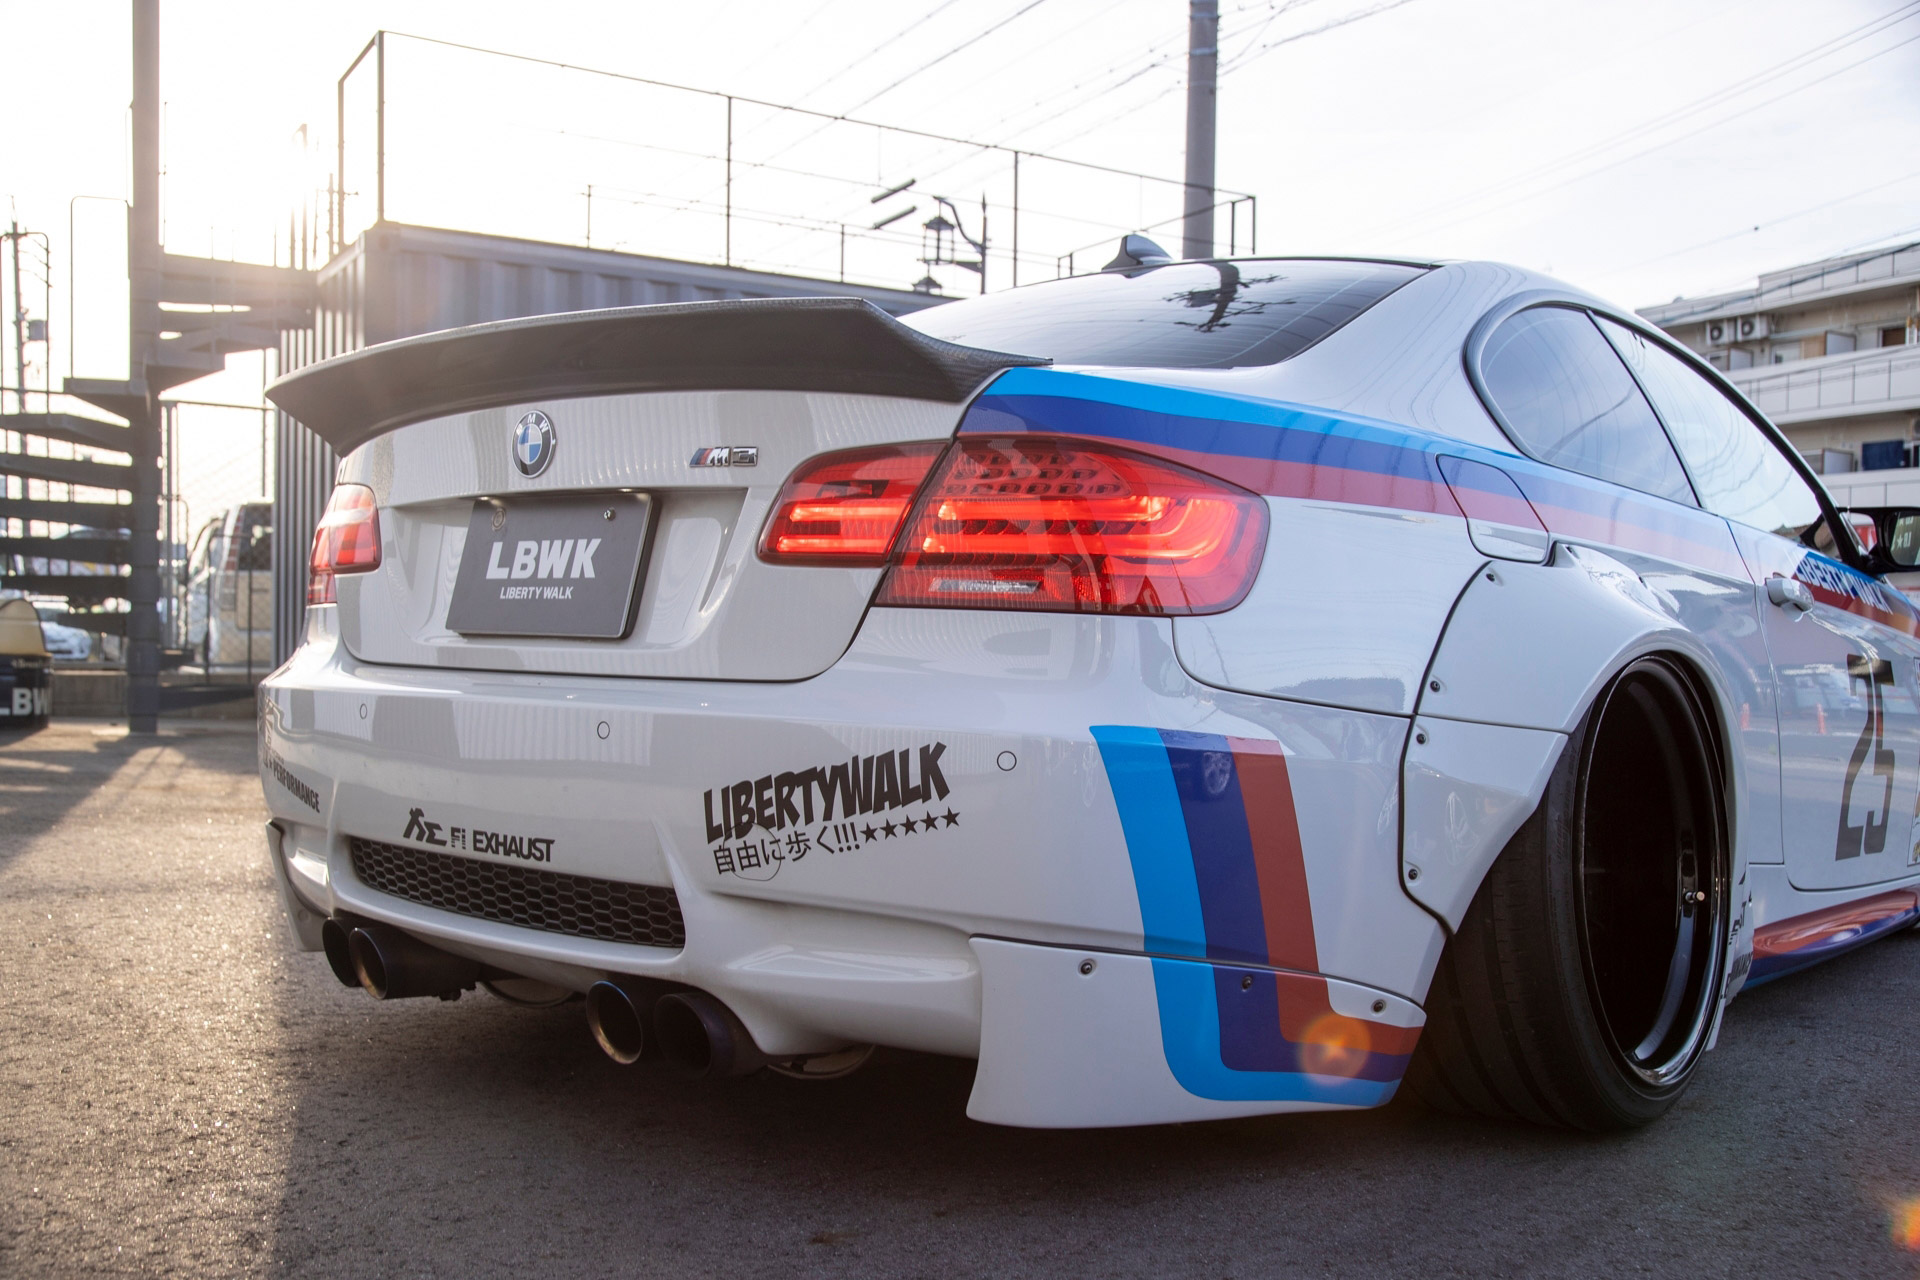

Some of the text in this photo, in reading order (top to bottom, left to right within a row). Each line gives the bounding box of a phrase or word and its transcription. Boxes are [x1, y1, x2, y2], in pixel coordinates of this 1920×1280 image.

[515, 413, 549, 436] BMW
[704, 446, 758, 468] M3
[486, 538, 601, 579] LBWK
[500, 586, 574, 599] LIBERTY WALK
[1835, 654, 1895, 861] 25
[473, 829, 555, 863] EXHAUST
